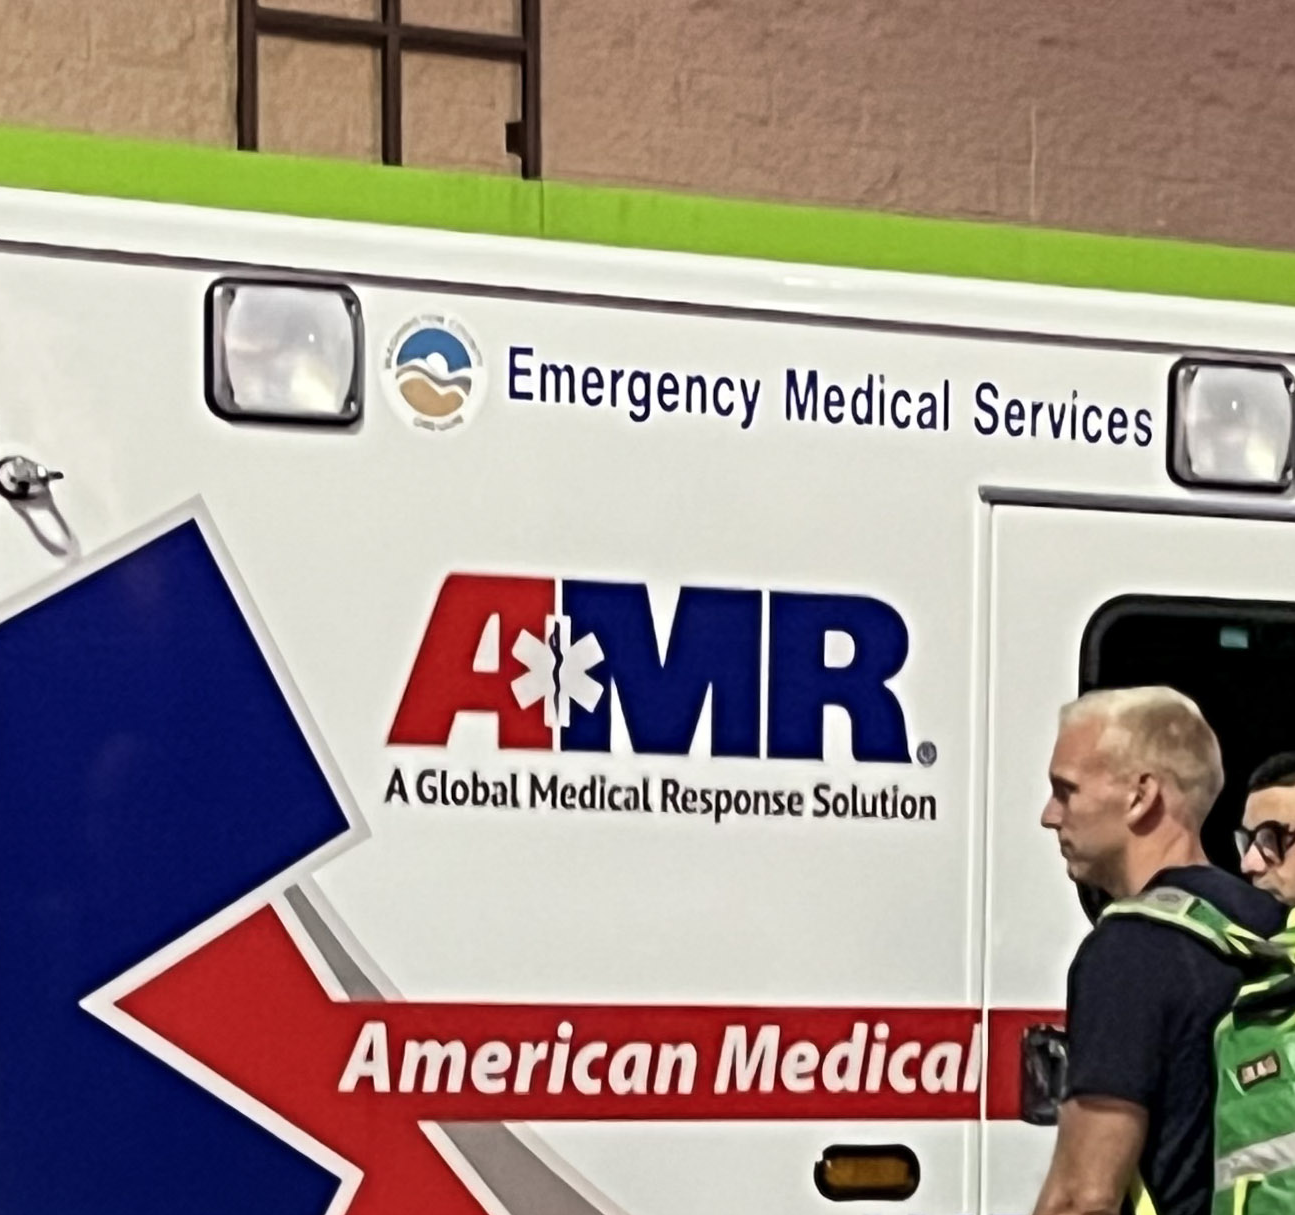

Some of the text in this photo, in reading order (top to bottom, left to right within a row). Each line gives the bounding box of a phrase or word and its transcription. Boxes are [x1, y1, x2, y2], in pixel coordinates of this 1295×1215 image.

[508, 345, 1154, 448] Emergency Medical Services
[386, 571, 913, 764] AMR
[384, 767, 937, 824] A Global Medical Response Solution
[337, 1019, 982, 1097] American Medical
